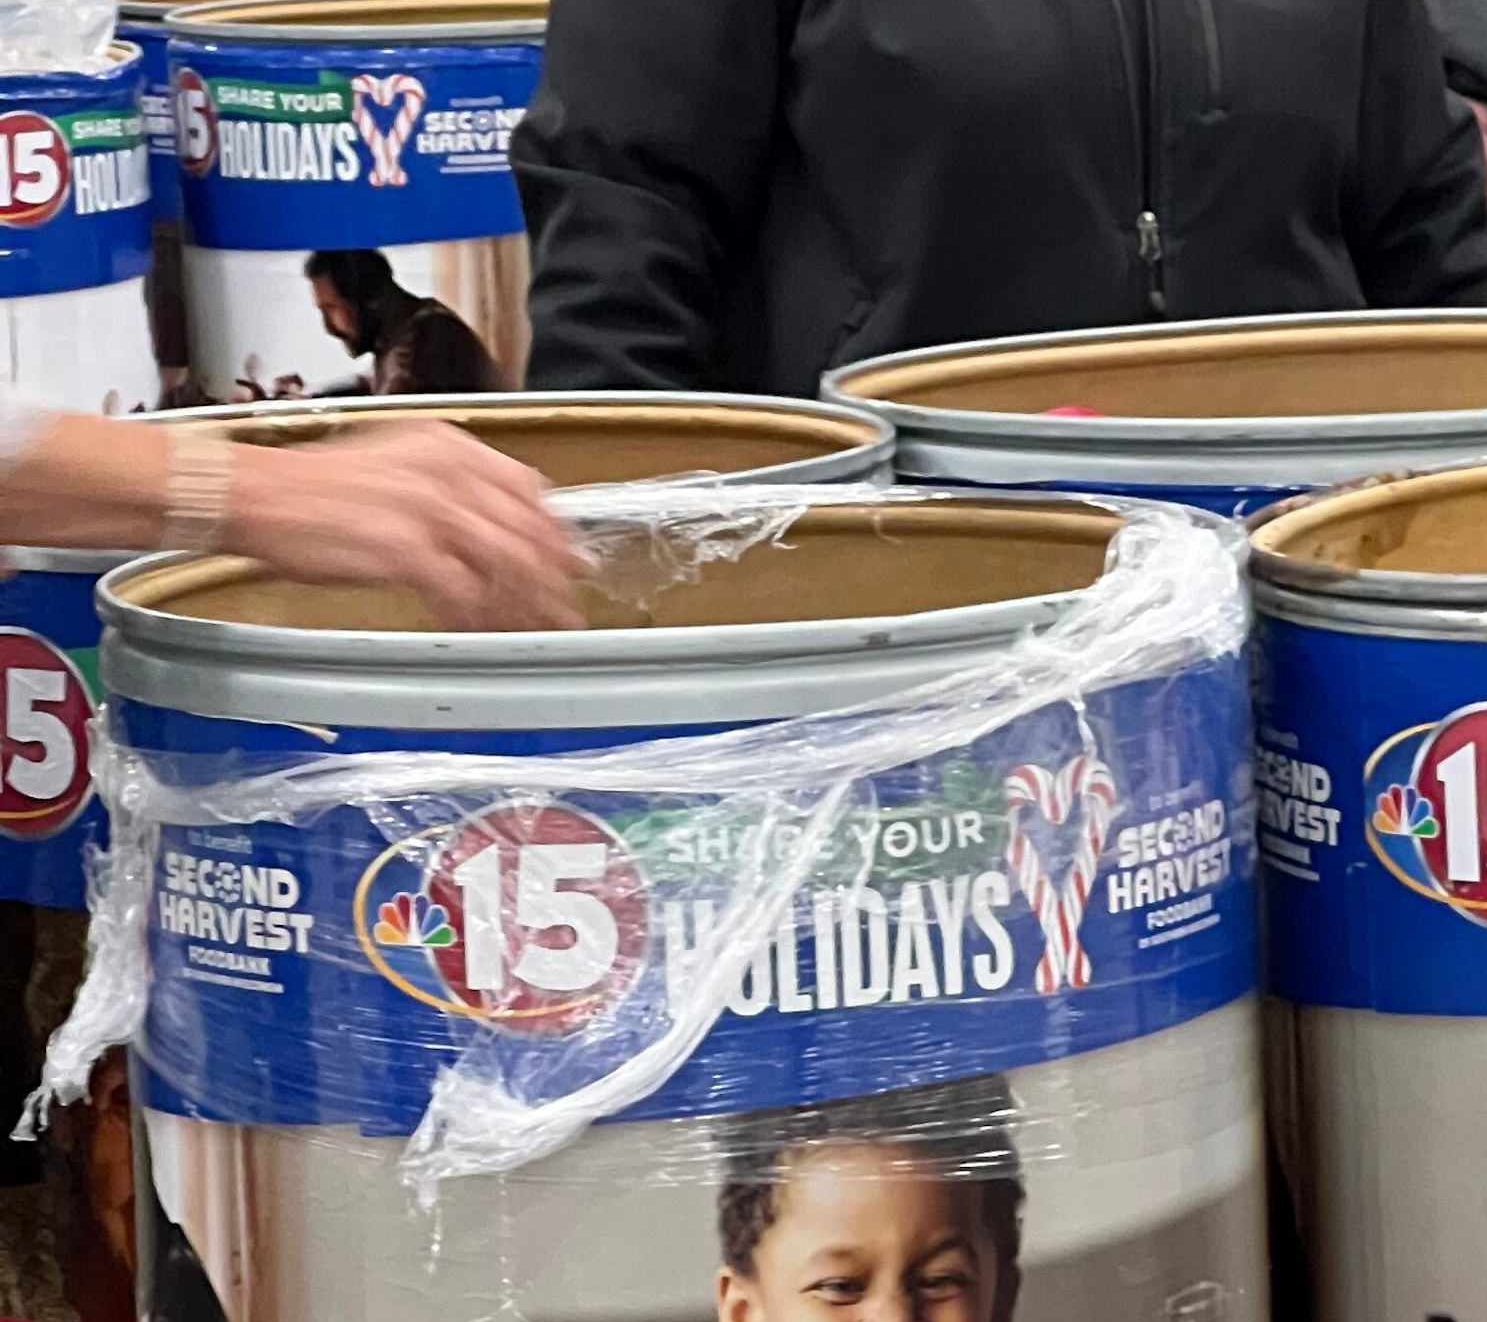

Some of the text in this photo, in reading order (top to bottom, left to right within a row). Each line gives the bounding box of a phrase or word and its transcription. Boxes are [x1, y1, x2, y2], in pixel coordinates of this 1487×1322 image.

[71, 118, 123, 140] SHARE
[217, 85, 344, 112] SHARE YOUR
[216, 119, 361, 181] HOLIDAYS
[0, 667, 77, 800] 5
[855, 811, 985, 860] YOUR
[1117, 799, 1225, 869] SECOND
[164, 851, 300, 909] SECOND
[1107, 838, 1232, 914] HARVEST
[158, 890, 315, 954] HARVEST
[452, 842, 620, 992] 15
